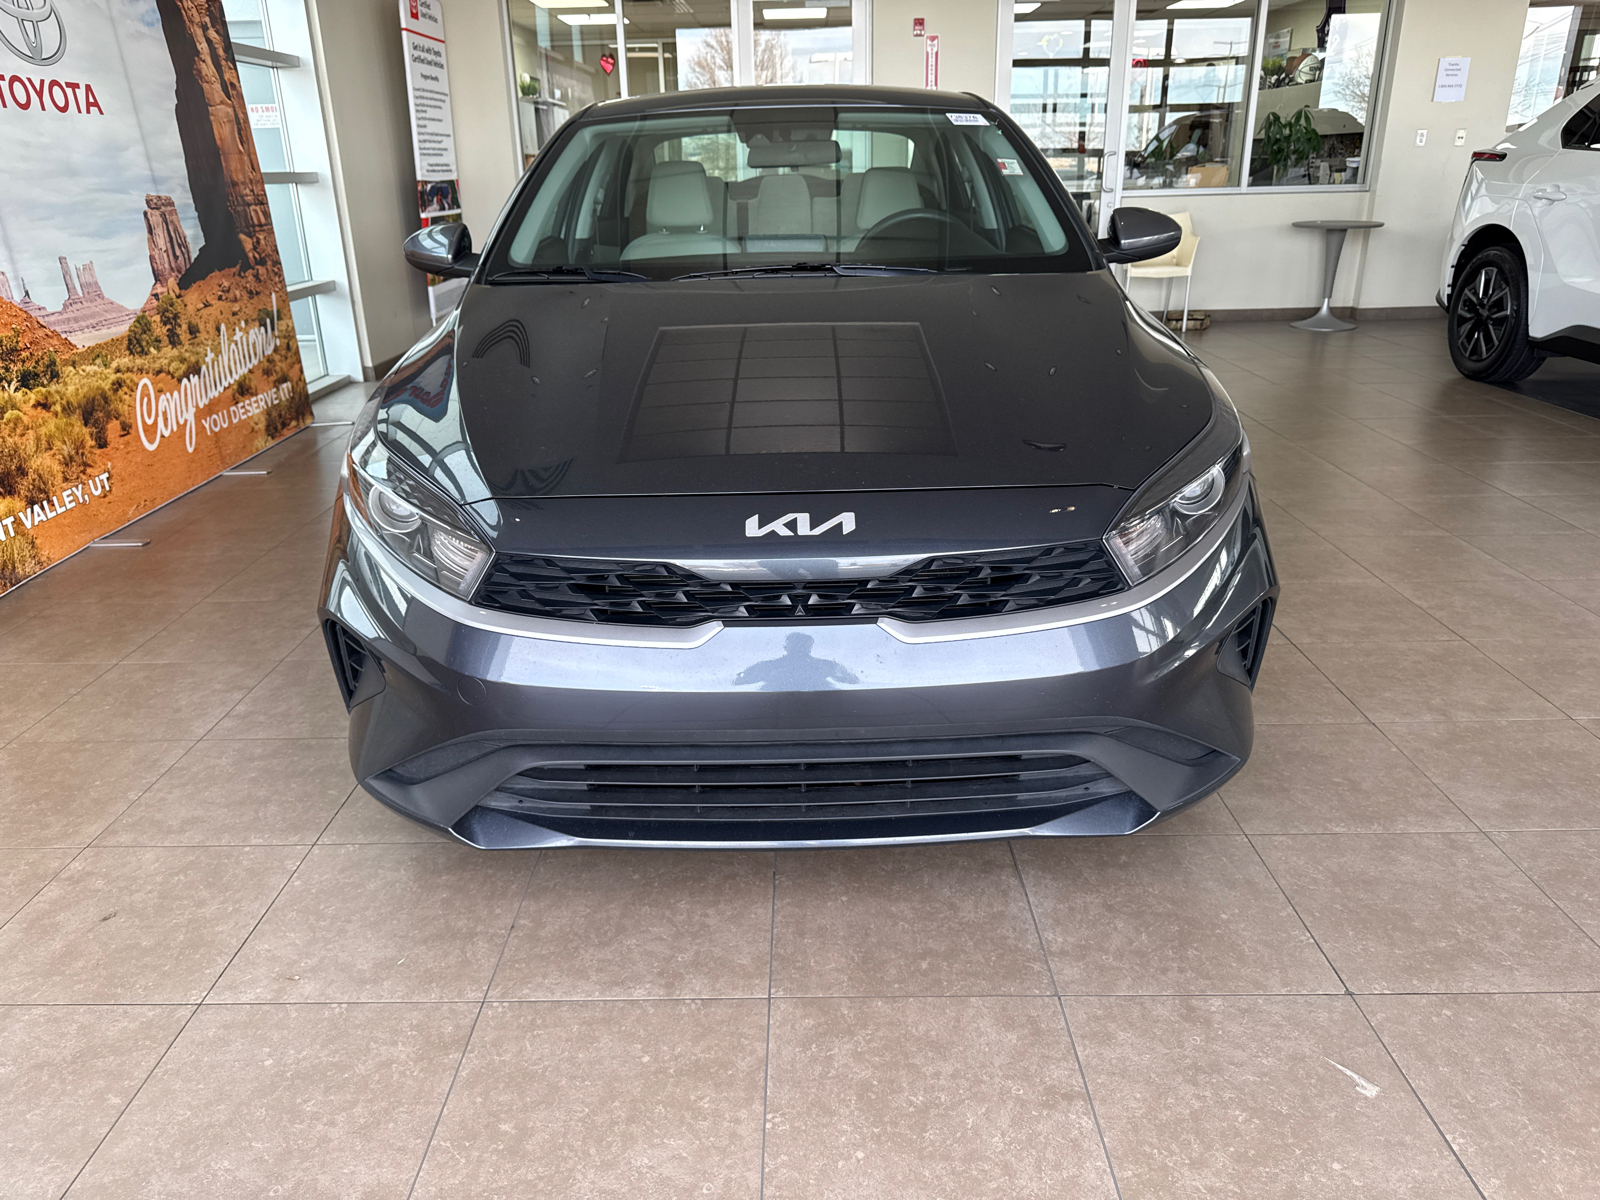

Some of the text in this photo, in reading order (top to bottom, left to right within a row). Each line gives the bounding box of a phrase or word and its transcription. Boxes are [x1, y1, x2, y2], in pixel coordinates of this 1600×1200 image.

[0, 74, 104, 115] TOYOTA
[136, 292, 280, 453] Congratulations!
[201, 381, 294, 436] YOU DESERVE IT!
[18, 484, 90, 530] VALLEY,
[88, 472, 111, 496] UT
[745, 512, 856, 537] KIA
